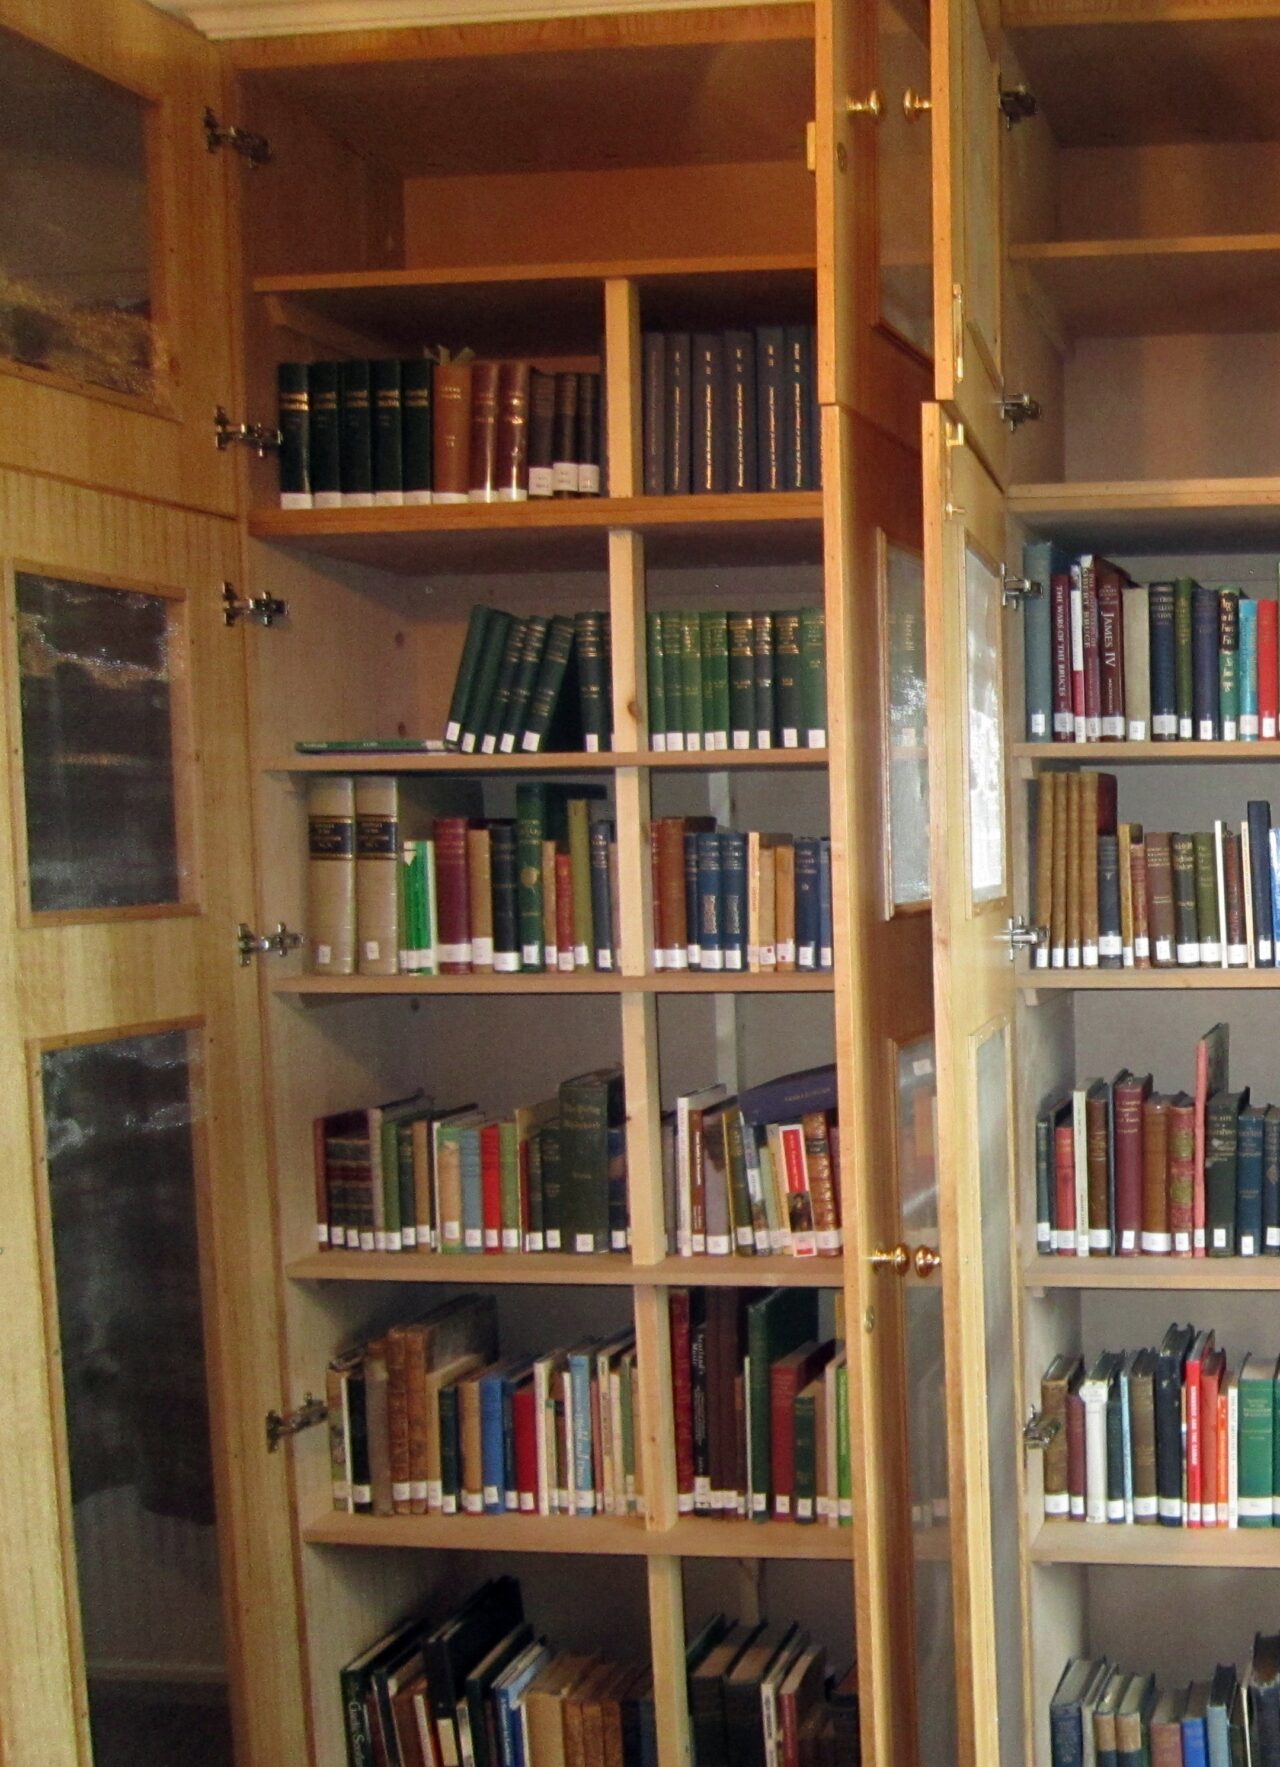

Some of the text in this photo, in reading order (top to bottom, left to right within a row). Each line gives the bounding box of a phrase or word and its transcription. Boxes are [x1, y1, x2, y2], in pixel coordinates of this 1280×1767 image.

[1101, 611, 1115, 647] JAMES
[1105, 652, 1116, 667] IV
[1058, 664, 1066, 696] BRUCES
